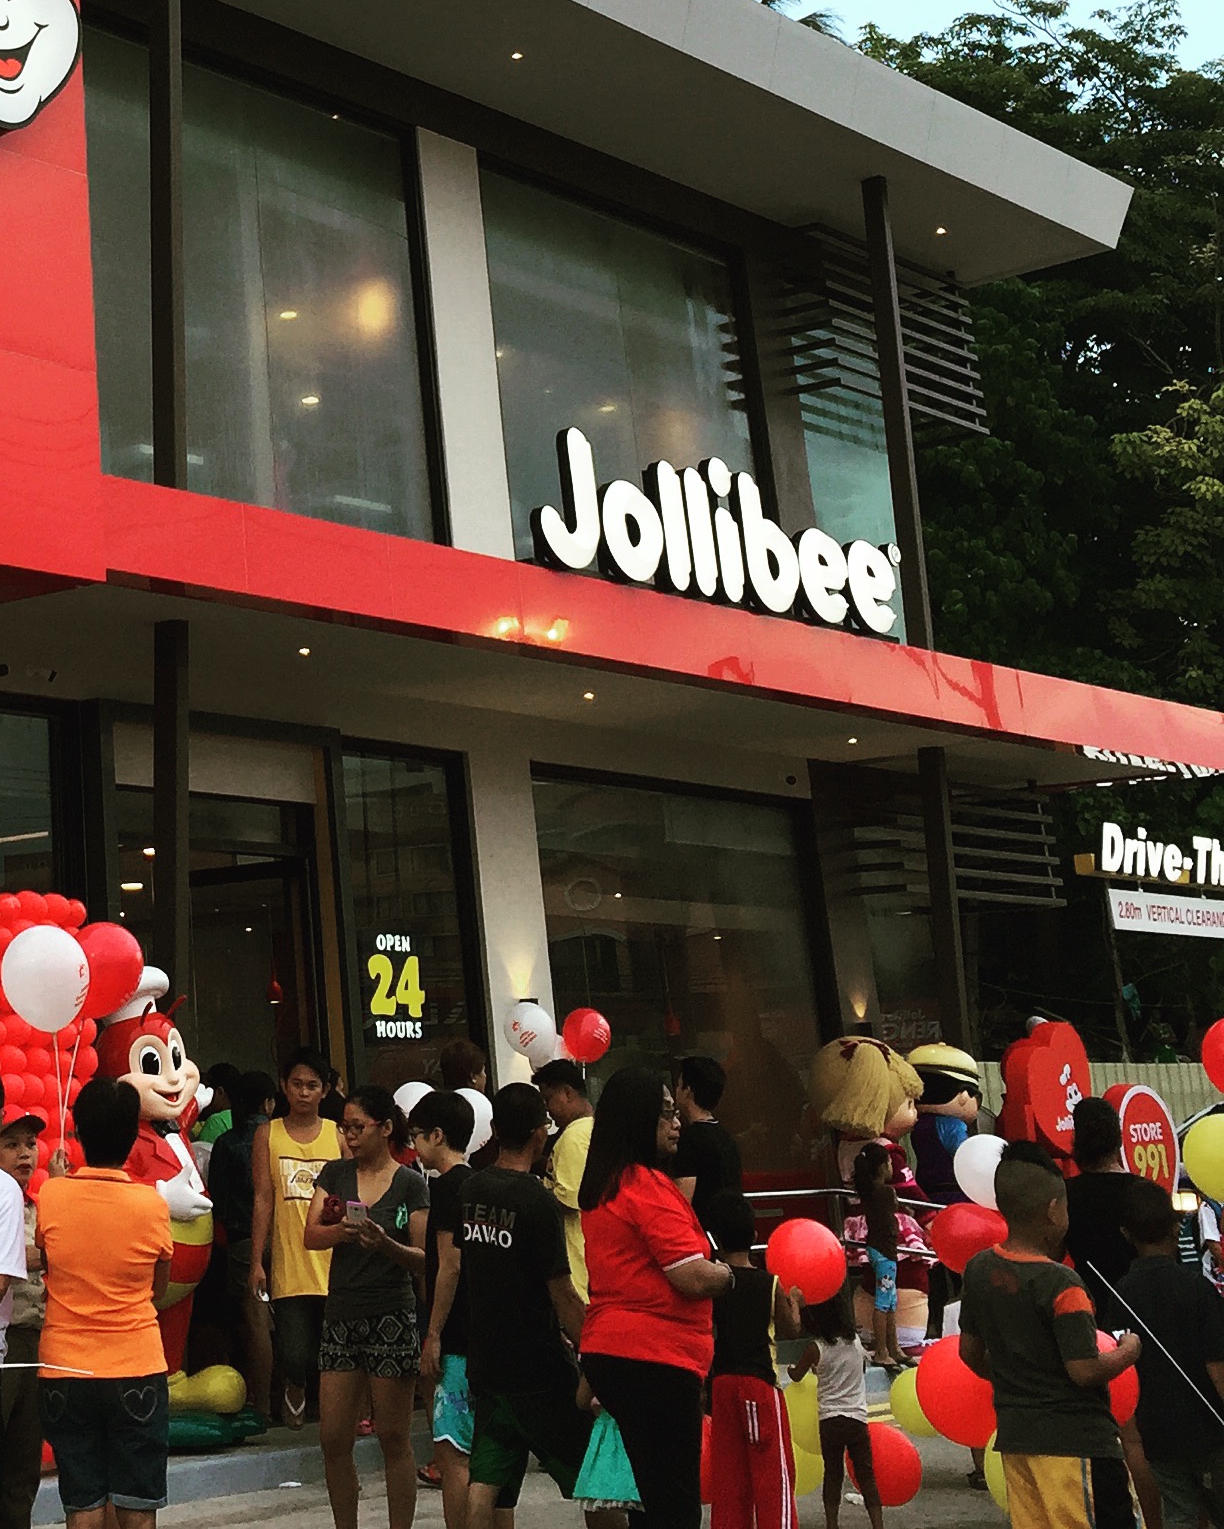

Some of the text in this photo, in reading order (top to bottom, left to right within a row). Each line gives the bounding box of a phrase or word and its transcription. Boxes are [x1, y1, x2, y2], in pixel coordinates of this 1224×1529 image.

[536, 426, 897, 634] Jollibee
[1101, 822, 1224, 886] Drive-Th
[1146, 904, 1185, 925] VERTICAL
[376, 934, 410, 952] OPEN
[368, 953, 425, 1018] 24
[376, 1020, 423, 1039] HOURS
[1129, 1122, 1164, 1143] STORE
[1134, 1144, 1169, 1181] 991
[463, 1203, 517, 1229] TEAM
[463, 1223, 513, 1248] DAVAO
